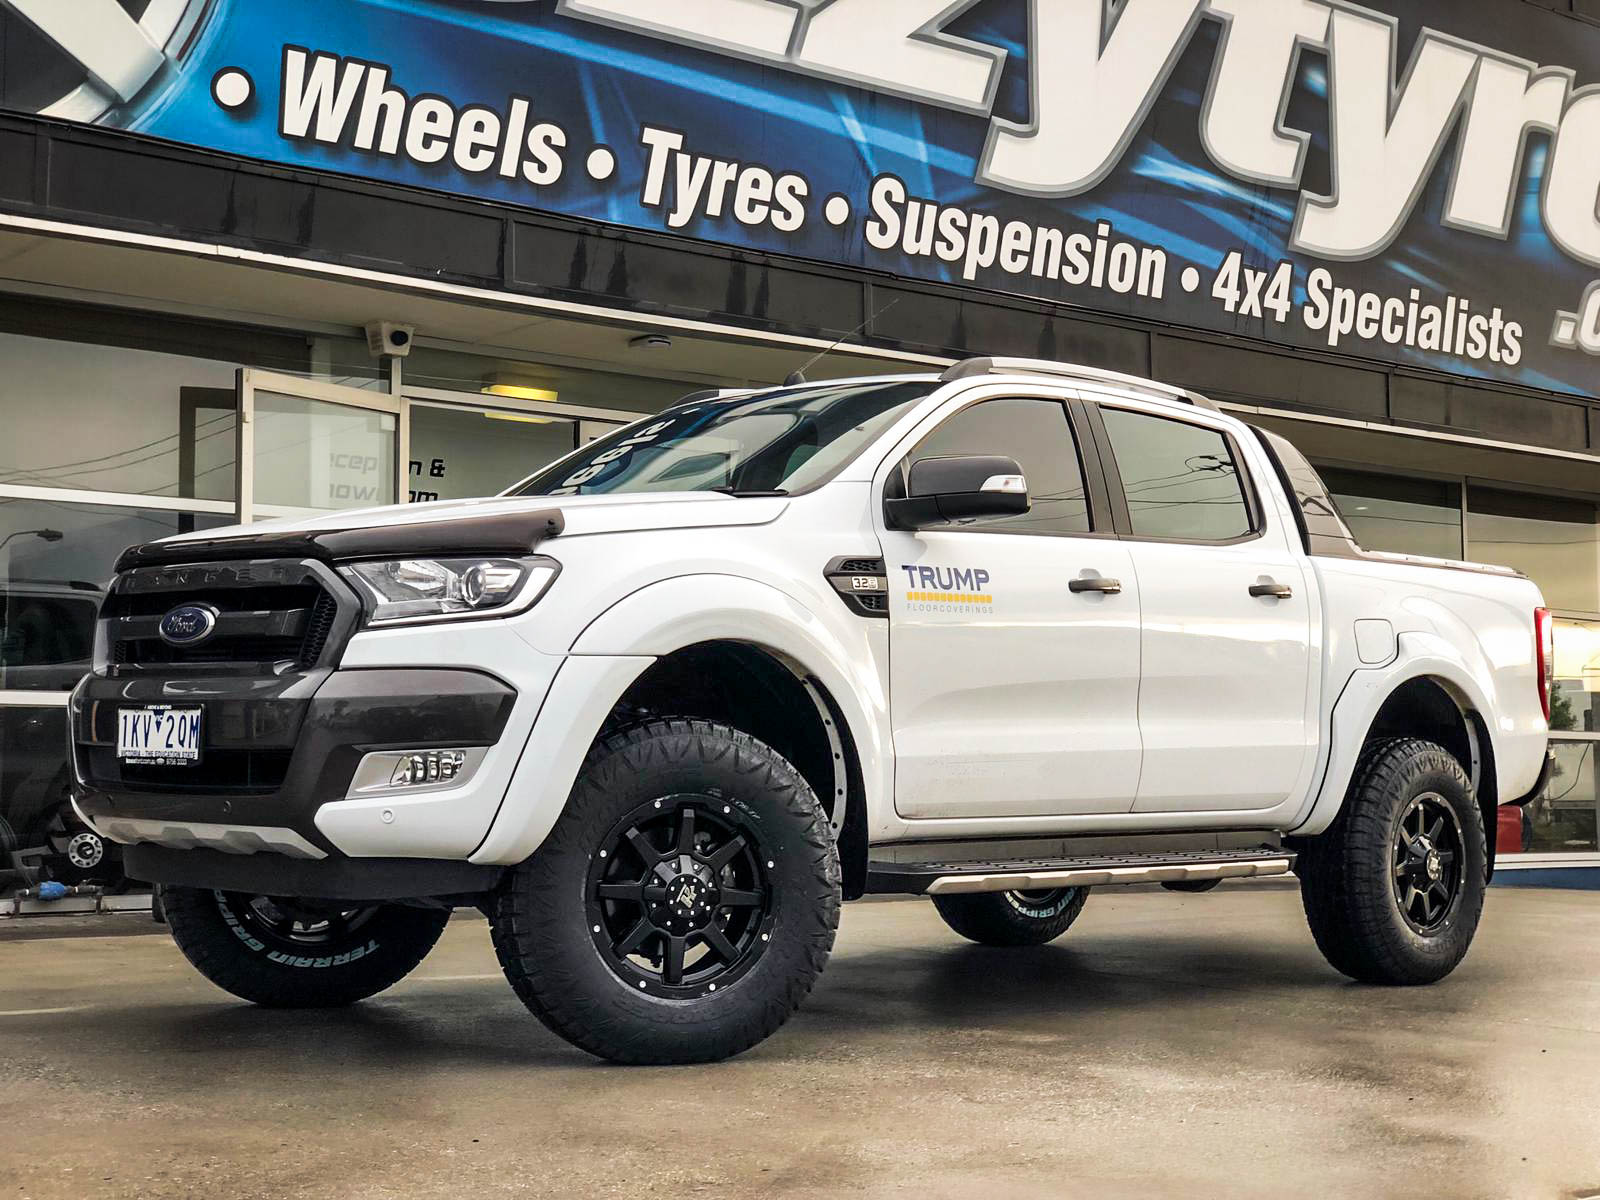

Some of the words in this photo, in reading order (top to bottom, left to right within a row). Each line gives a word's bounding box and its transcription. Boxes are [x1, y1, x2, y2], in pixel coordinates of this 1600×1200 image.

[283, 49, 566, 185] Wheels
[642, 127, 808, 231] Tyres
[865, 177, 1167, 299] Suspension
[1211, 251, 1292, 322] 4x4
[1303, 267, 1523, 365] Specialists
[902, 565, 990, 591] TRUMP
[906, 603, 993, 614] FLOORCOVERINGS
[123, 715, 151, 747] 1KV
[165, 715, 200, 749] 2QM
[267, 939, 380, 968] TERRAIN
